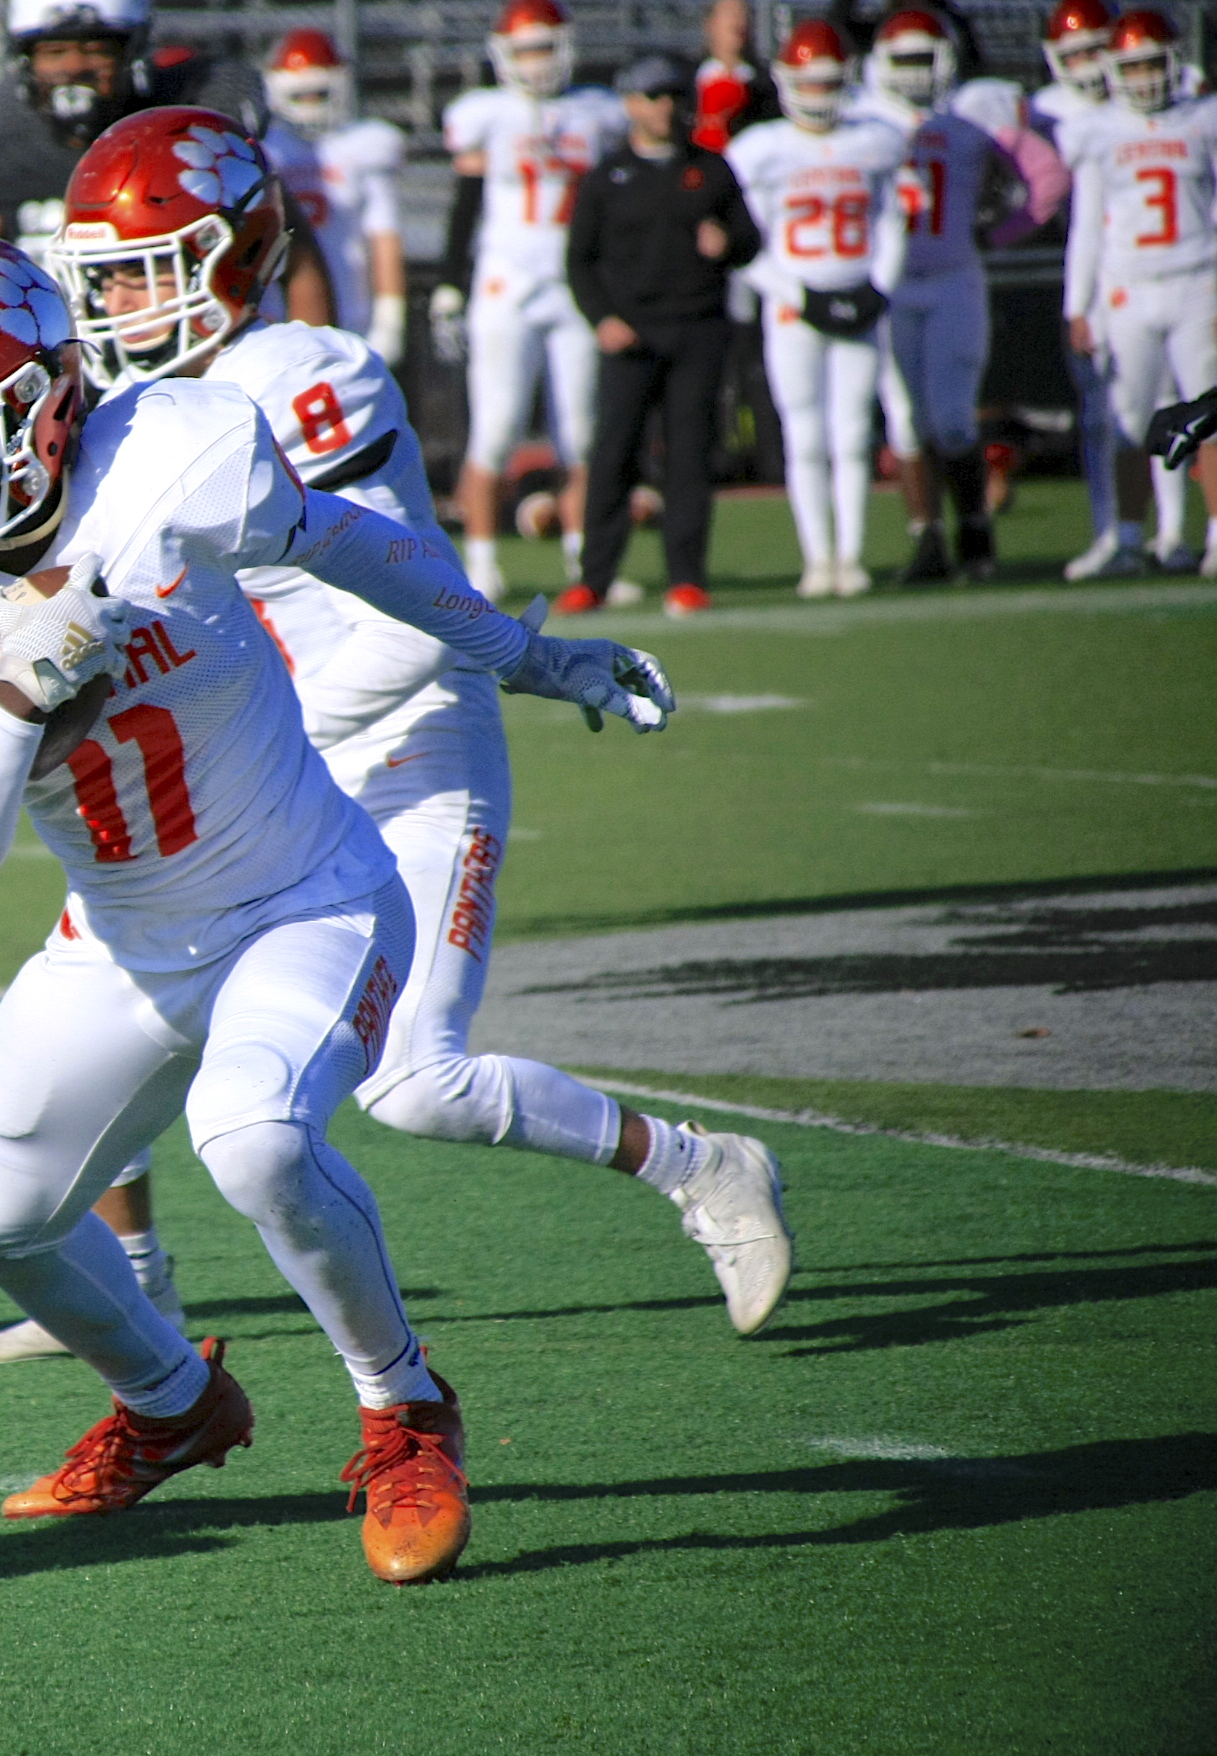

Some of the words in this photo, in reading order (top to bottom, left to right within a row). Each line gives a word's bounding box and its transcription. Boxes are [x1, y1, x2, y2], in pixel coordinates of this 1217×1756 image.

[785, 190, 870, 258] 28
[1135, 166, 1177, 247] 3
[292, 381, 352, 454] 8
[385, 538, 417, 563] RIP
[65, 703, 199, 862] 11
